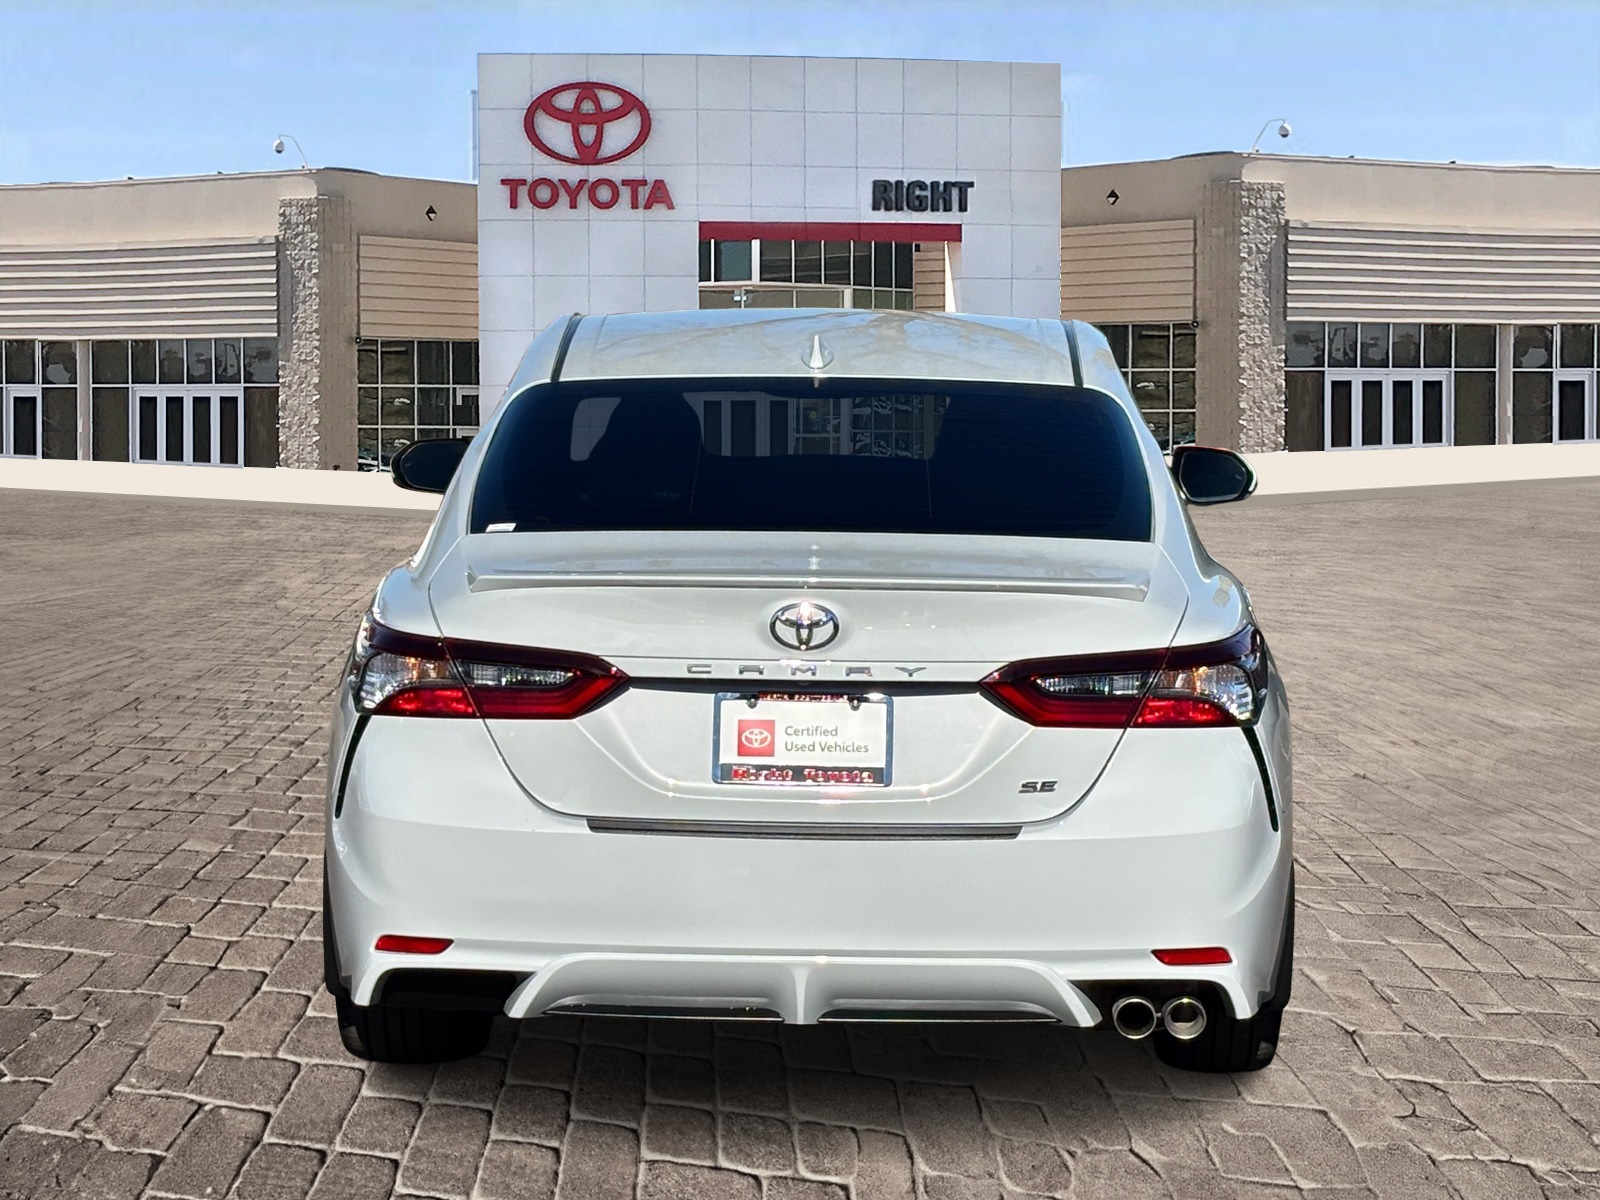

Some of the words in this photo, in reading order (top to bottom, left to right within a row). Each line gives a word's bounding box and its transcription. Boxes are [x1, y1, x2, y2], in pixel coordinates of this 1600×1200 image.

[500, 178, 675, 210] TOYOTA
[871, 179, 975, 213] RIGHT
[686, 663, 927, 677] CAMRY
[784, 725, 838, 737] Certified
[784, 741, 816, 752] Used
[818, 742, 869, 753] Vehicles
[803, 768, 875, 783] Toyota
[1018, 780, 1059, 794] SE
